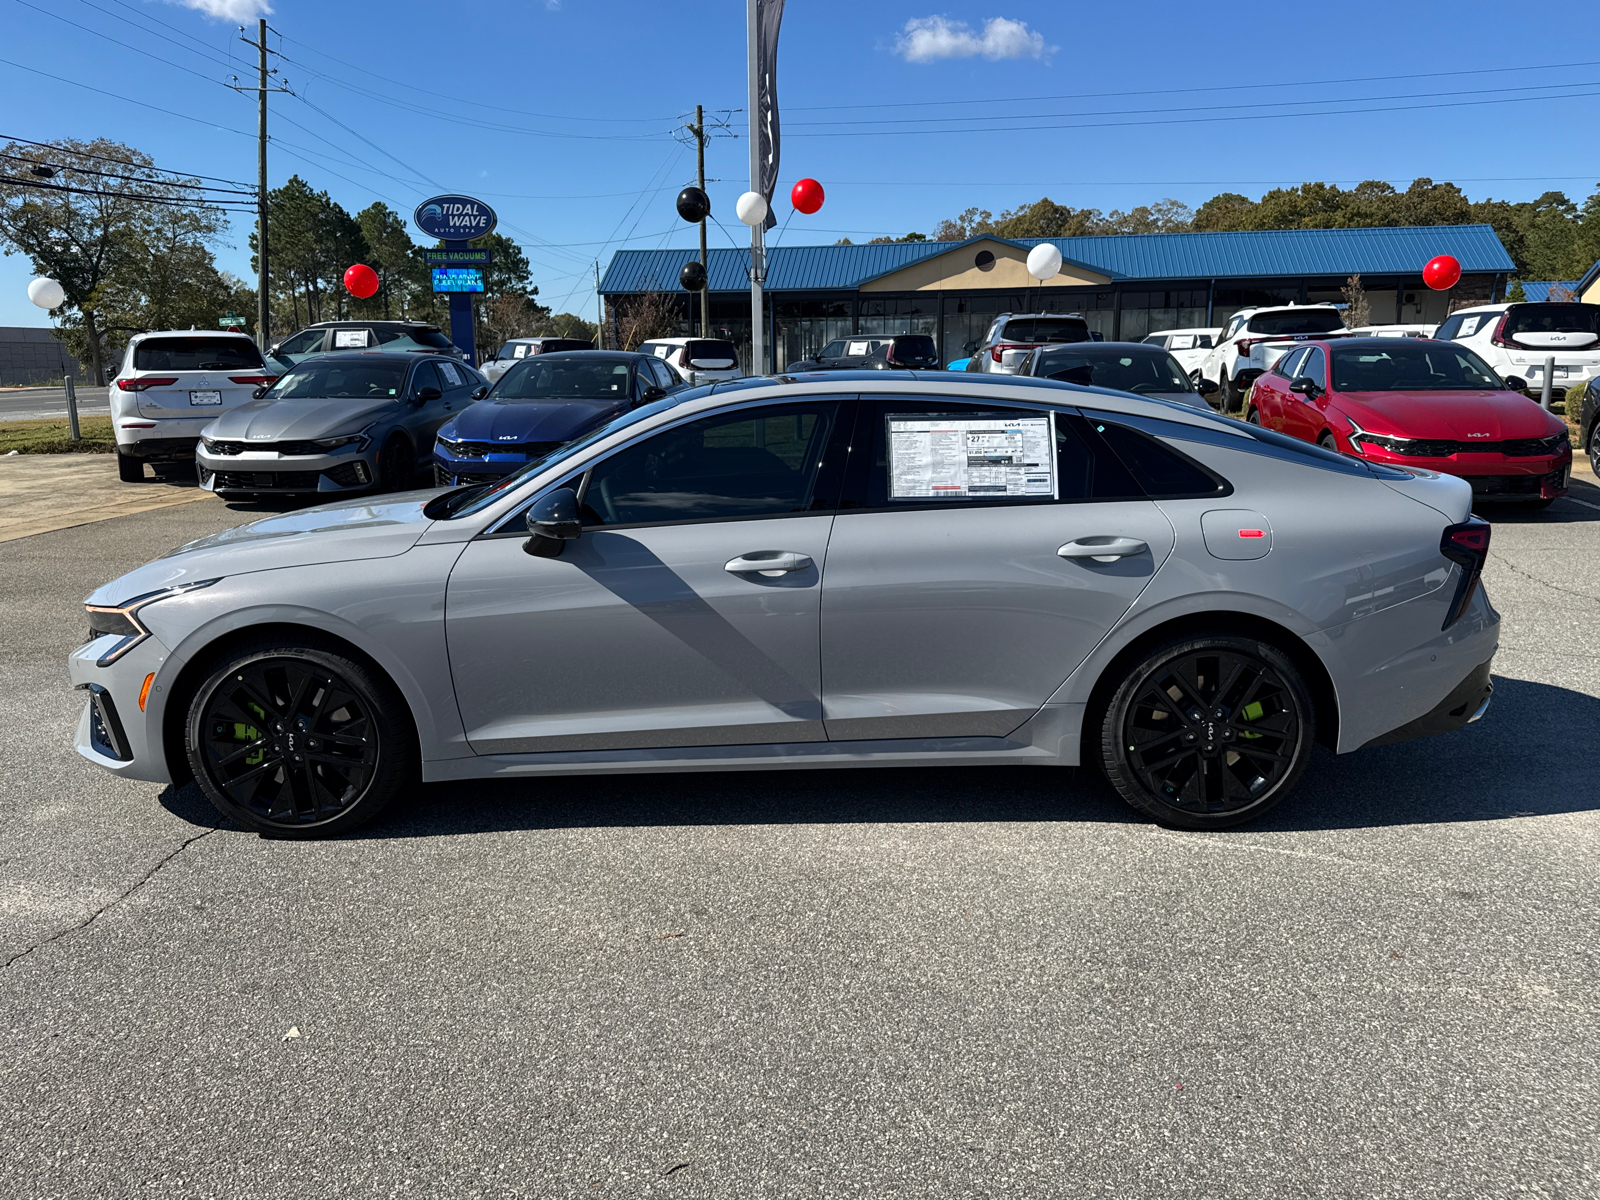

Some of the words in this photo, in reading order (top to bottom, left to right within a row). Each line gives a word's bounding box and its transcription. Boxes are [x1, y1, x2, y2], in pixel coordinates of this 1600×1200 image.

[442, 204, 479, 215] TIDAL
[449, 216, 487, 227] WAVE
[426, 252, 447, 260] FREE
[449, 252, 486, 260] VACUUMS
[970, 435, 980, 443] 27
